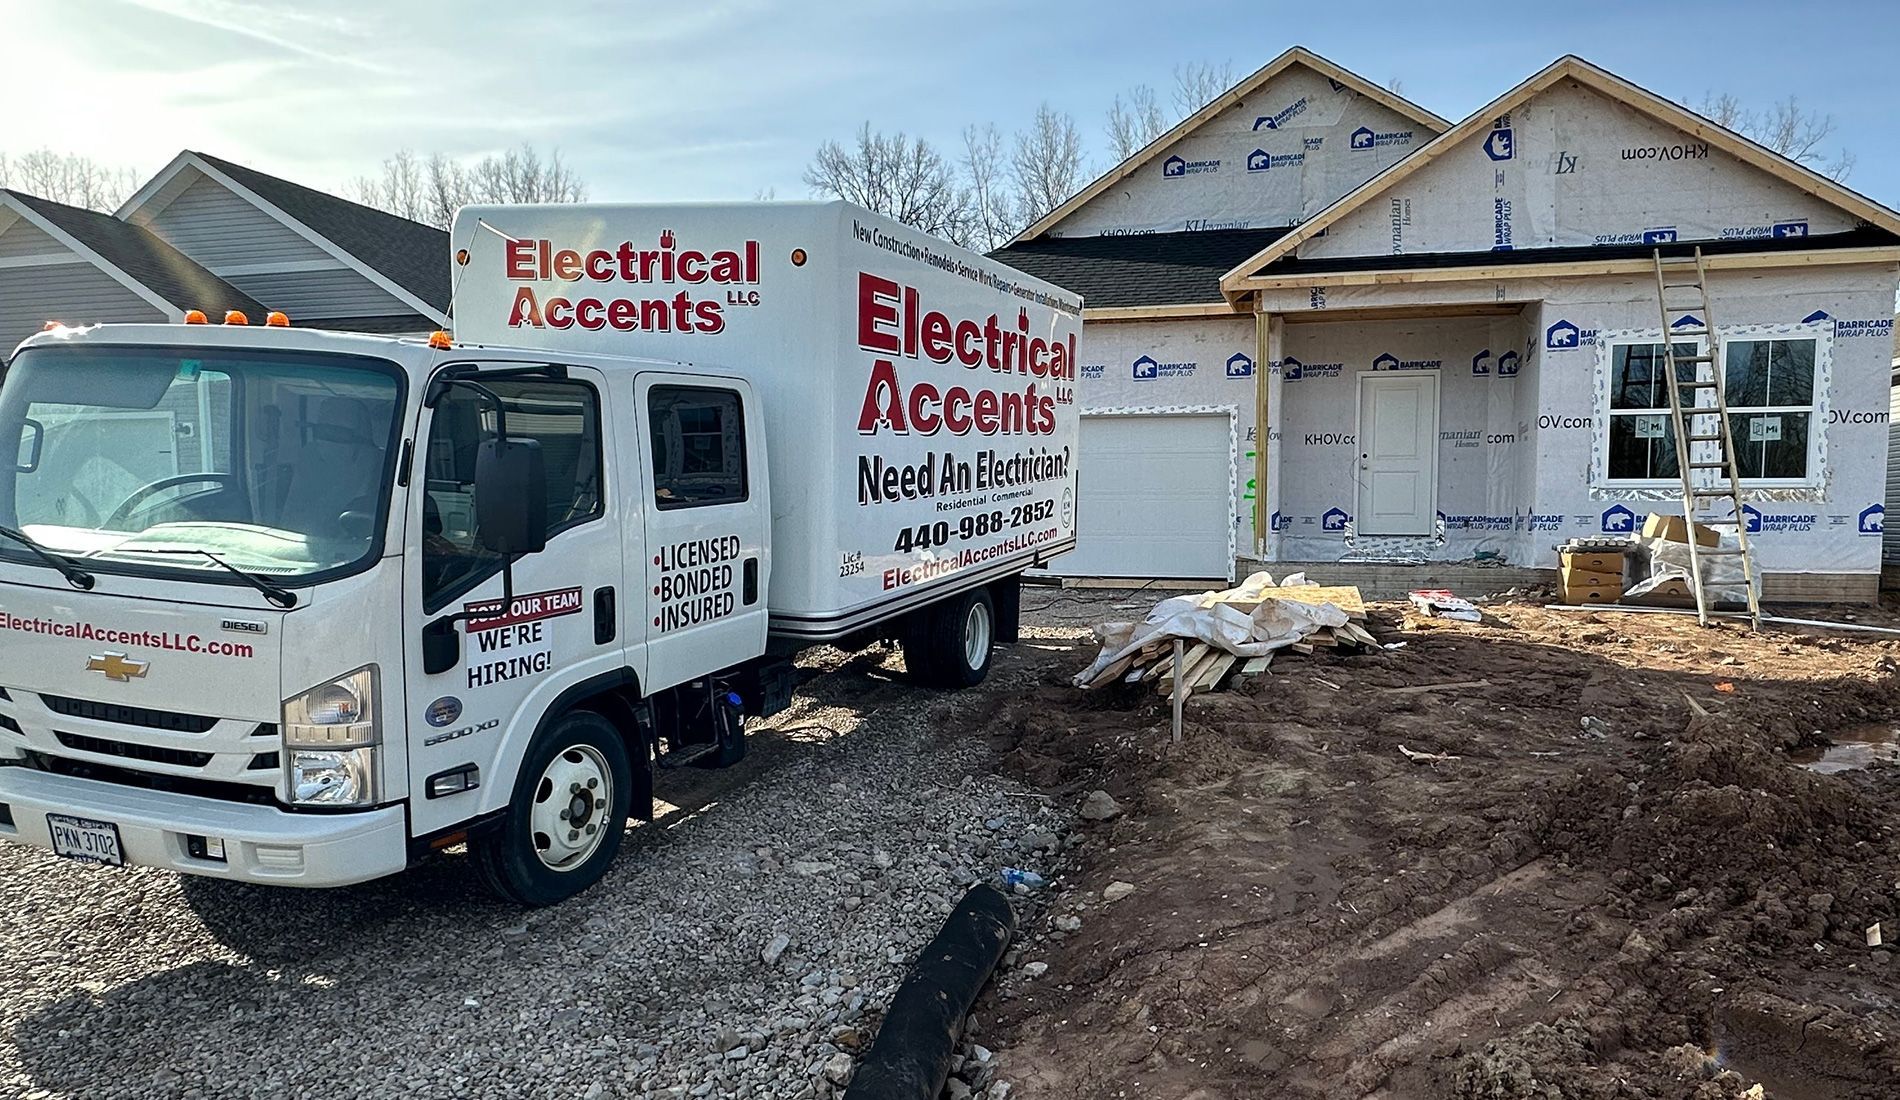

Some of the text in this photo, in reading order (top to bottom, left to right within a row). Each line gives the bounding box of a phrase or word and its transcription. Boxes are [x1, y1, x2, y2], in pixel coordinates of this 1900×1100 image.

[1375, 132, 1413, 140] BARRICADE
[1375, 139, 1392, 147] WRAP
[1622, 144, 1708, 161] KHOV.com
[1495, 197, 1503, 244] BARRICADE
[1503, 200, 1512, 244] WRAP PLUS
[506, 231, 760, 284] Electrical
[853, 219, 872, 244] New
[873, 228, 921, 262] Construction
[924, 247, 955, 273] Remodels
[957, 260, 978, 282] Service
[508, 287, 760, 333] Accents LLC
[1838, 319, 1894, 329] BARRICADE
[858, 271, 1077, 381] Electrical
[1837, 328, 1889, 338] WRAP PLUS
[1158, 363, 1197, 371] BARRICADE
[857, 359, 1074, 436] Accents LLC
[858, 445, 1070, 505] Need An Electrician?
[936, 487, 1034, 512] Residential Commercial
[894, 499, 1055, 554] 440-988-2852
[1538, 523, 1559, 531] PLUS
[1762, 515, 1817, 523] BARRICADE
[1762, 523, 1812, 532] WRAP PLUS
[660, 535, 740, 572] LICENSED
[840, 561, 865, 577] 23254
[843, 551, 861, 564] Lic.#
[883, 527, 1058, 591] ElectricalAccentsLLC.com
[661, 565, 733, 603] BONDED
[511, 599, 542, 617] OUR
[543, 592, 580, 612] TEAM
[661, 592, 735, 633] INSURED
[0, 612, 254, 659] ElectricalAccentsLLC.com
[222, 620, 263, 633] DIESEL
[478, 622, 543, 653] WE'RE
[467, 651, 552, 689] HIRING!
[475, 719, 500, 733] XD
[55, 826, 117, 857] PKN 3702
